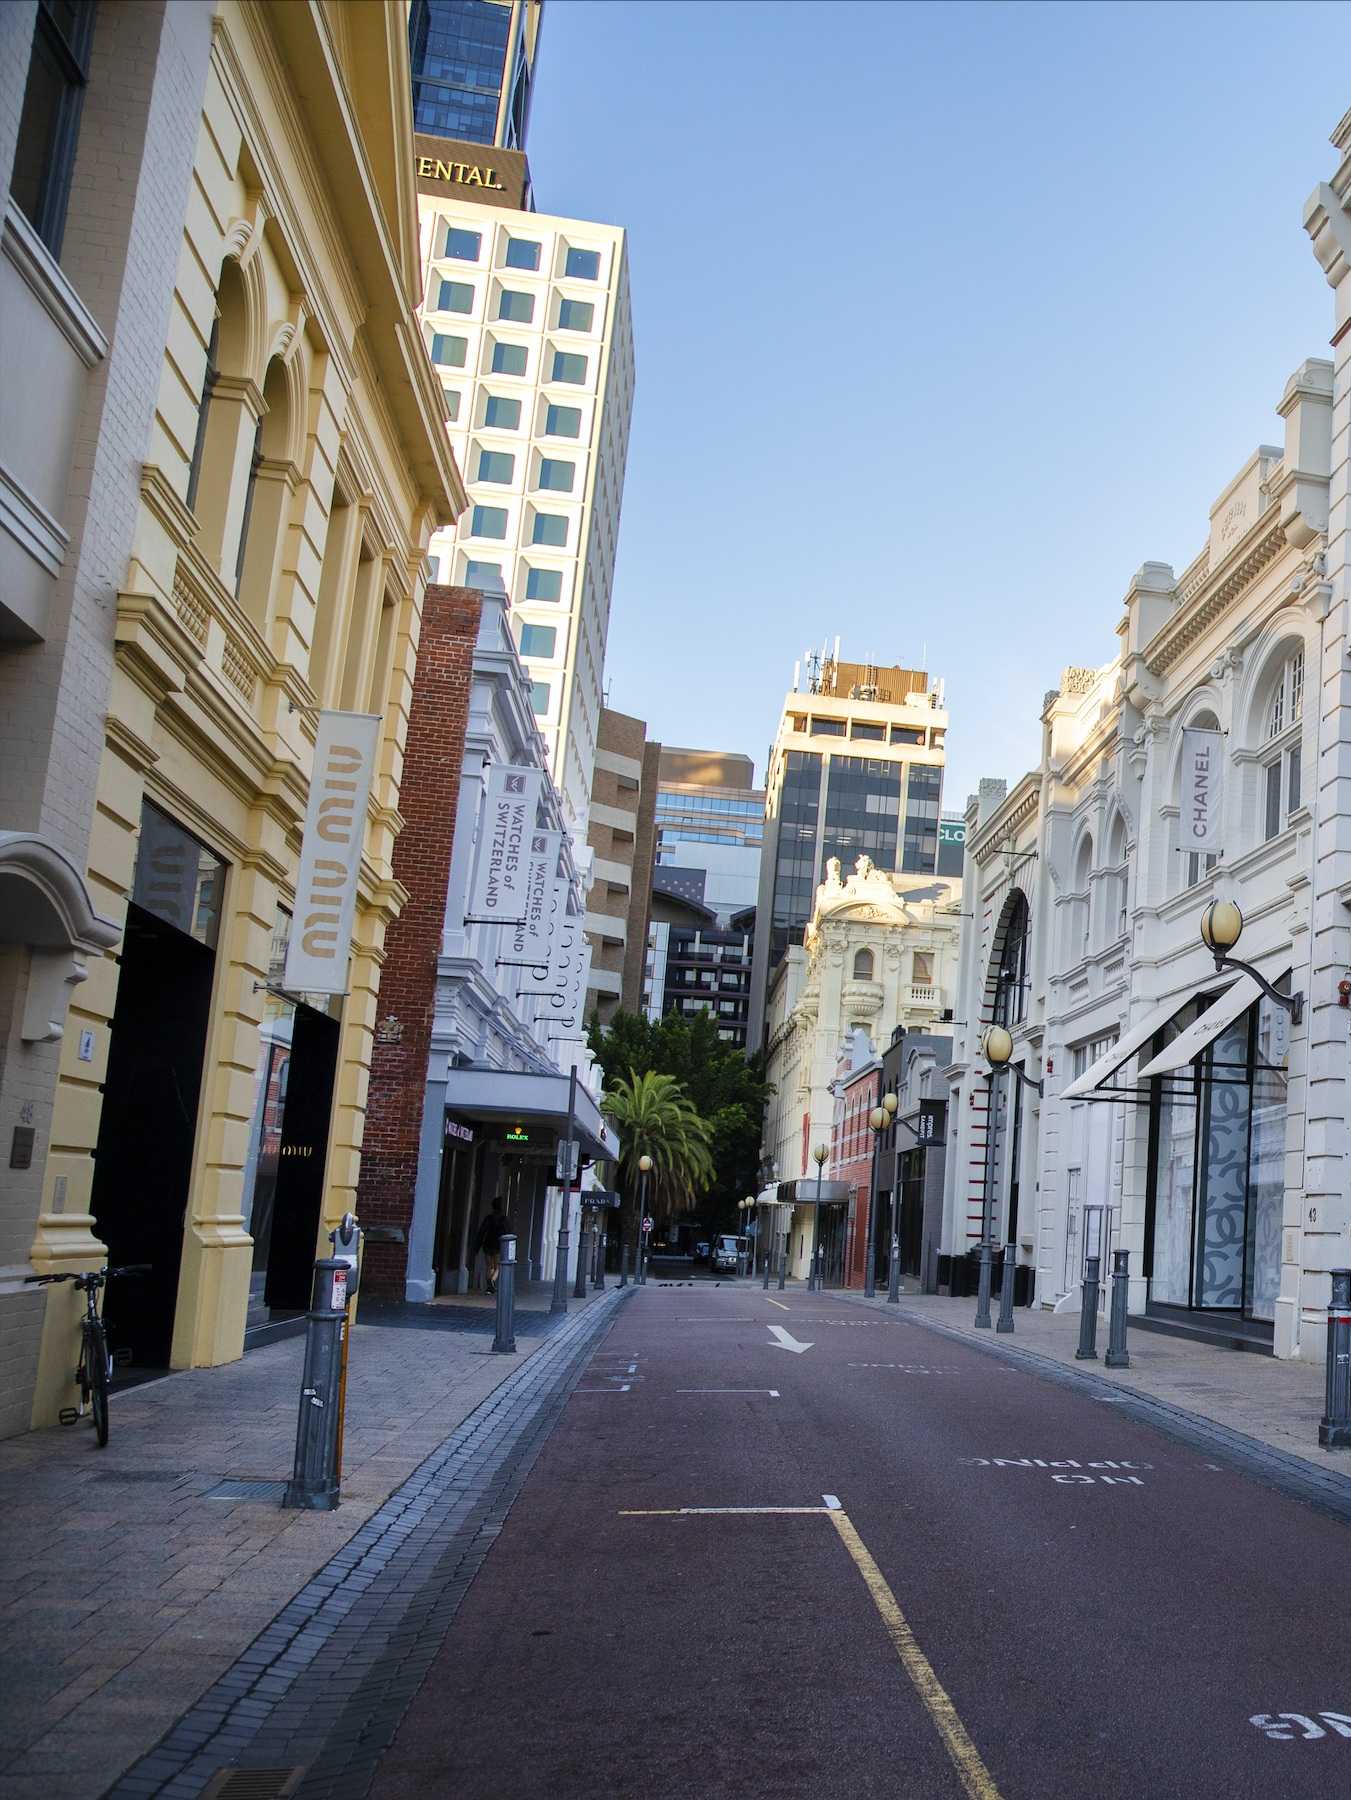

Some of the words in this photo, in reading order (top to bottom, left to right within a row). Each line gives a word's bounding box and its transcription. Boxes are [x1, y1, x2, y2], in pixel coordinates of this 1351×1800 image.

[416, 155, 503, 190] ENTAL.
[1193, 746, 1210, 838] CHANEL
[485, 803, 510, 908] SWITZERLAND
[506, 804, 526, 872] WATCHES
[503, 876, 515, 891] of
[531, 862, 548, 921] WATCHES
